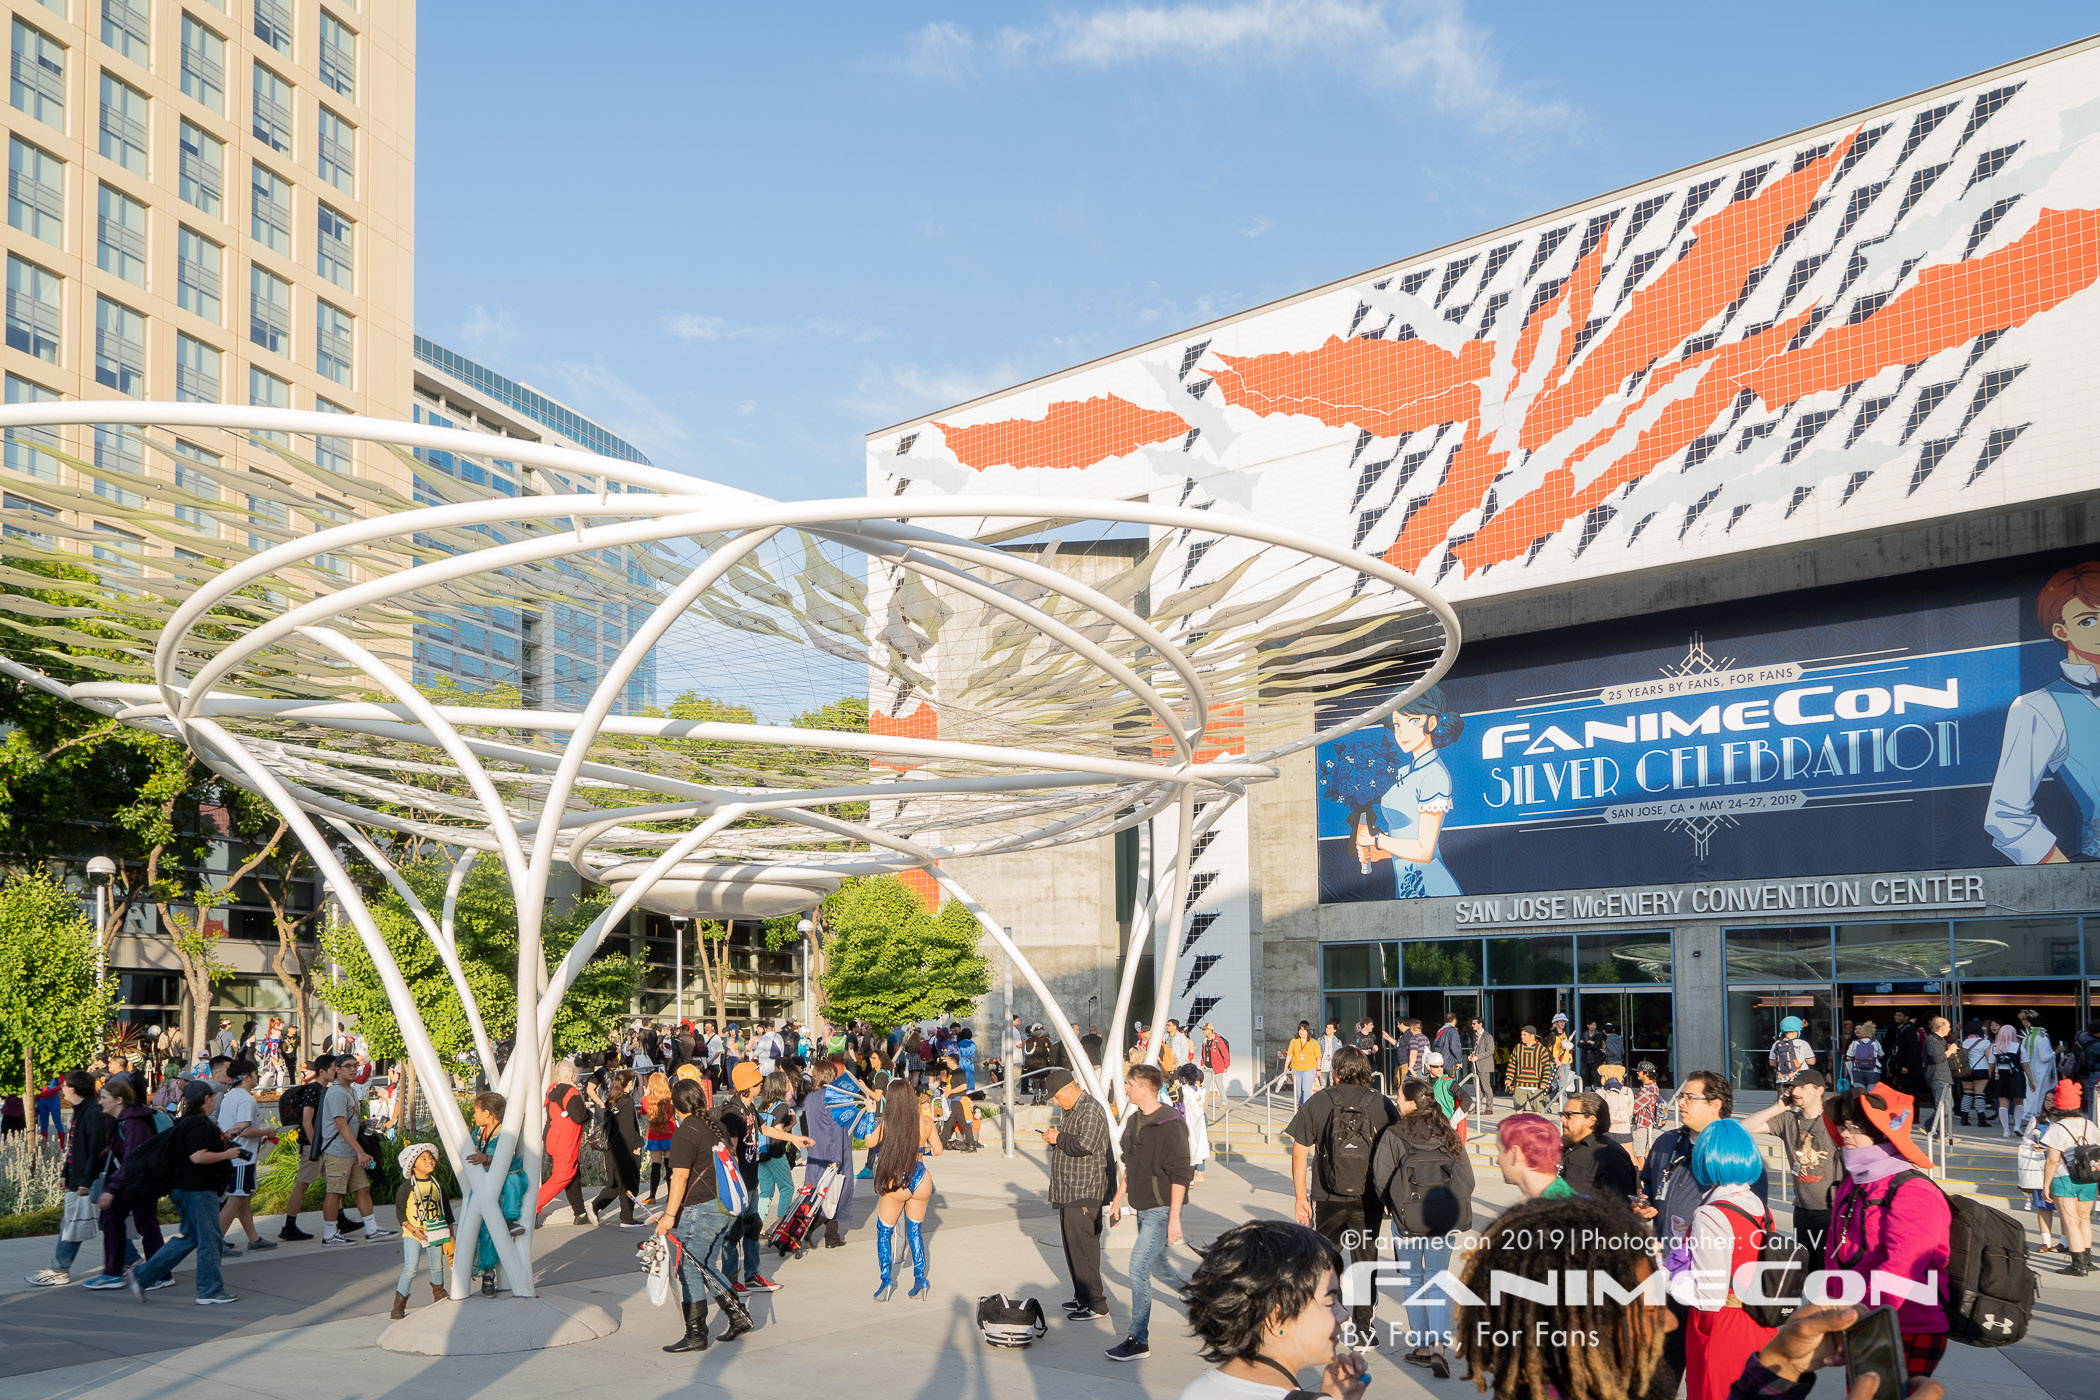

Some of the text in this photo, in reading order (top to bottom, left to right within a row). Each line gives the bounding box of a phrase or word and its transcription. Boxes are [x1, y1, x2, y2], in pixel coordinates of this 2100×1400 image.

[1608, 668, 1794, 701] 25 YEARS BY FANS, FOR FANS
[1483, 720, 1960, 808] SILVER CELEBRATION
[1611, 808, 1634, 819] SAN
[1637, 805, 1666, 817] JOSE,
[1669, 803, 1686, 814] CA
[1699, 800, 1724, 812] MAY
[1770, 794, 1797, 805] 2019
[1455, 875, 1985, 924] SAN JOSE McENERY CONVENTION CENTER
